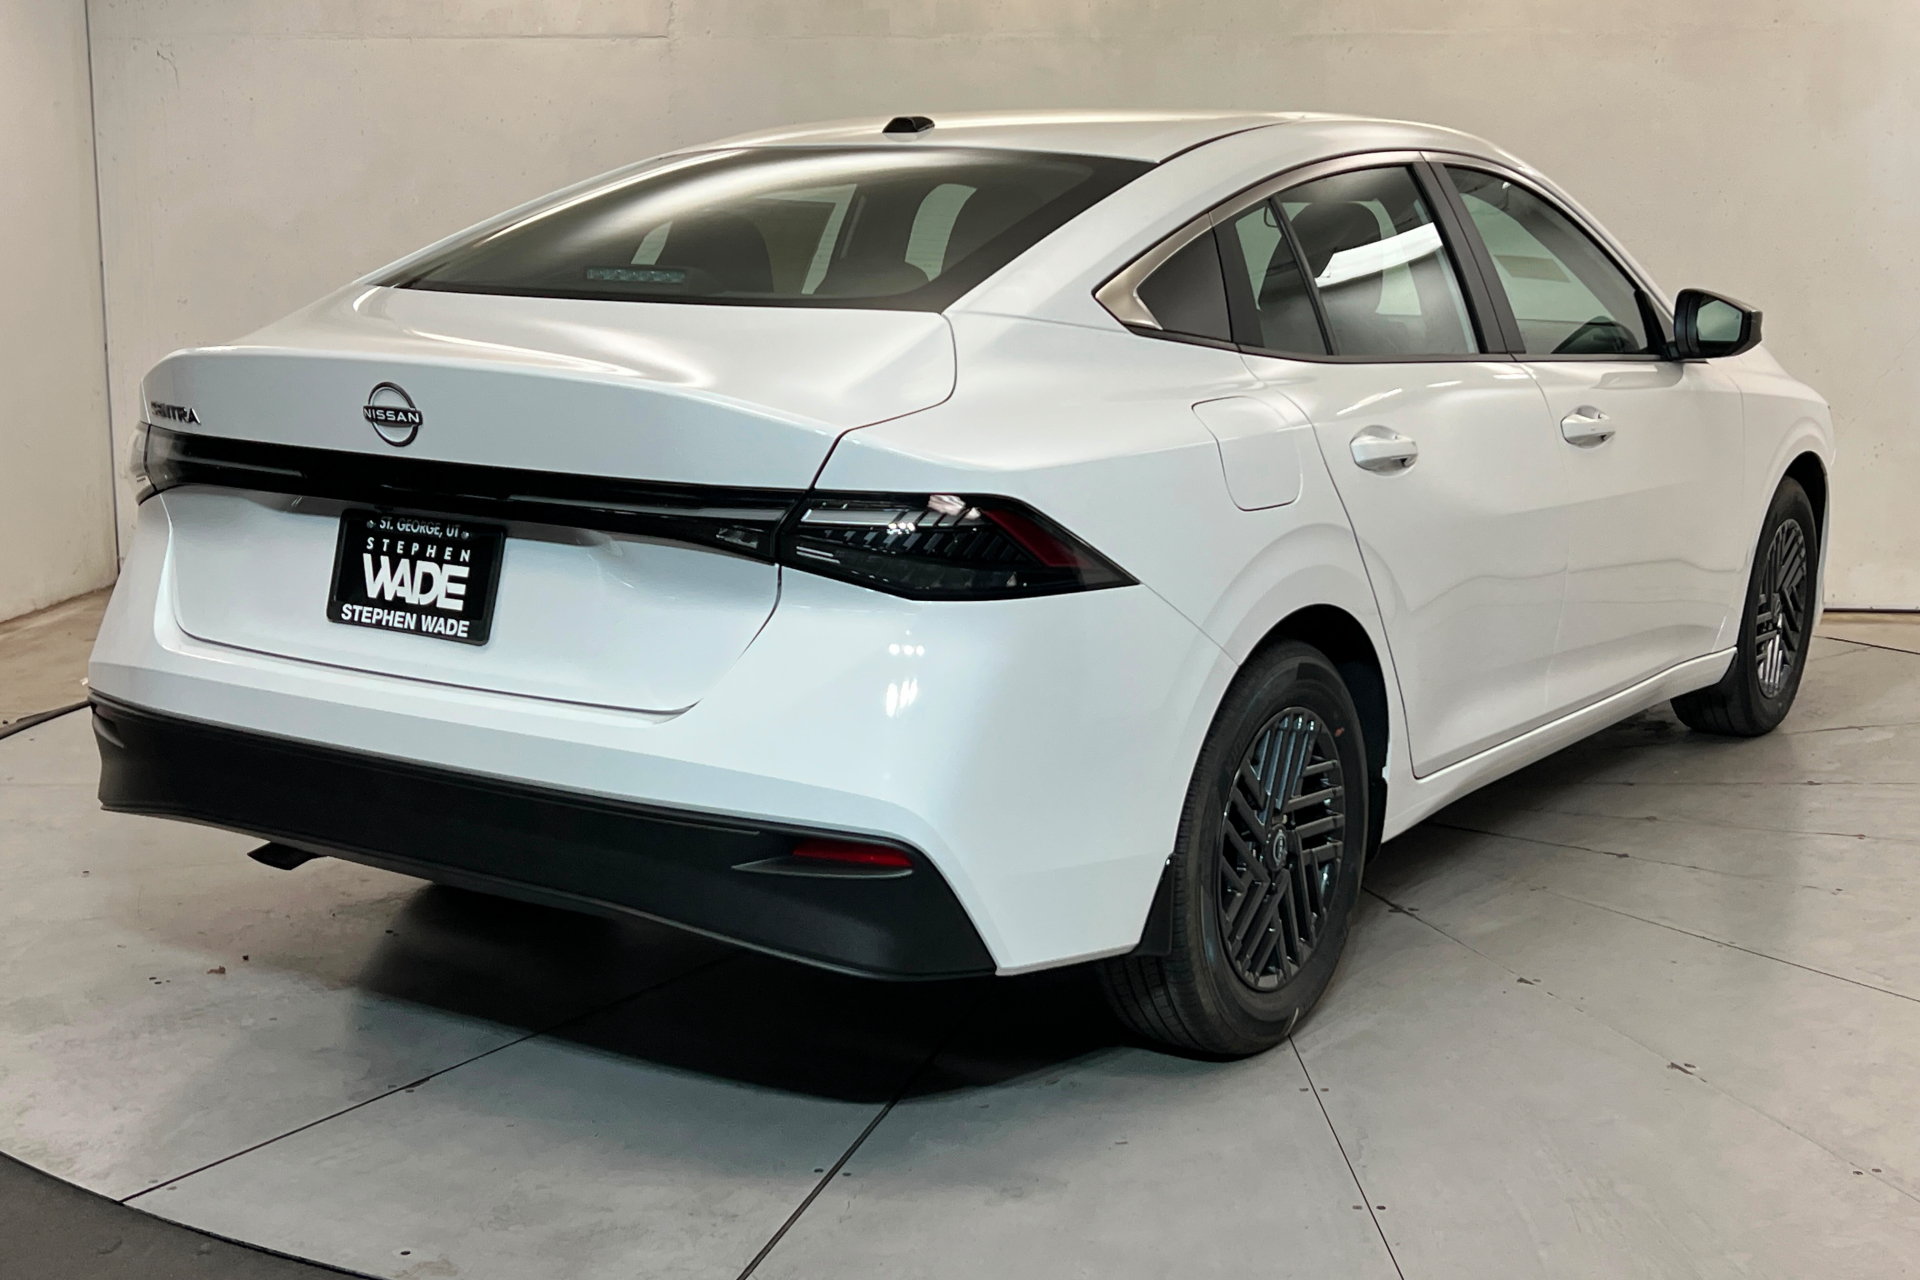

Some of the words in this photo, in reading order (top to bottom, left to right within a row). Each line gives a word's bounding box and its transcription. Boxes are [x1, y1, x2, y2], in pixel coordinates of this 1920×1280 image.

[363, 408, 420, 423] NISSAN
[379, 516, 394, 530] ST.
[396, 518, 443, 538] GEORGE,
[366, 537, 471, 562] STEPHEN
[363, 553, 470, 611] WADE
[341, 603, 417, 630] STEPHEN
[421, 615, 470, 638] WADE
